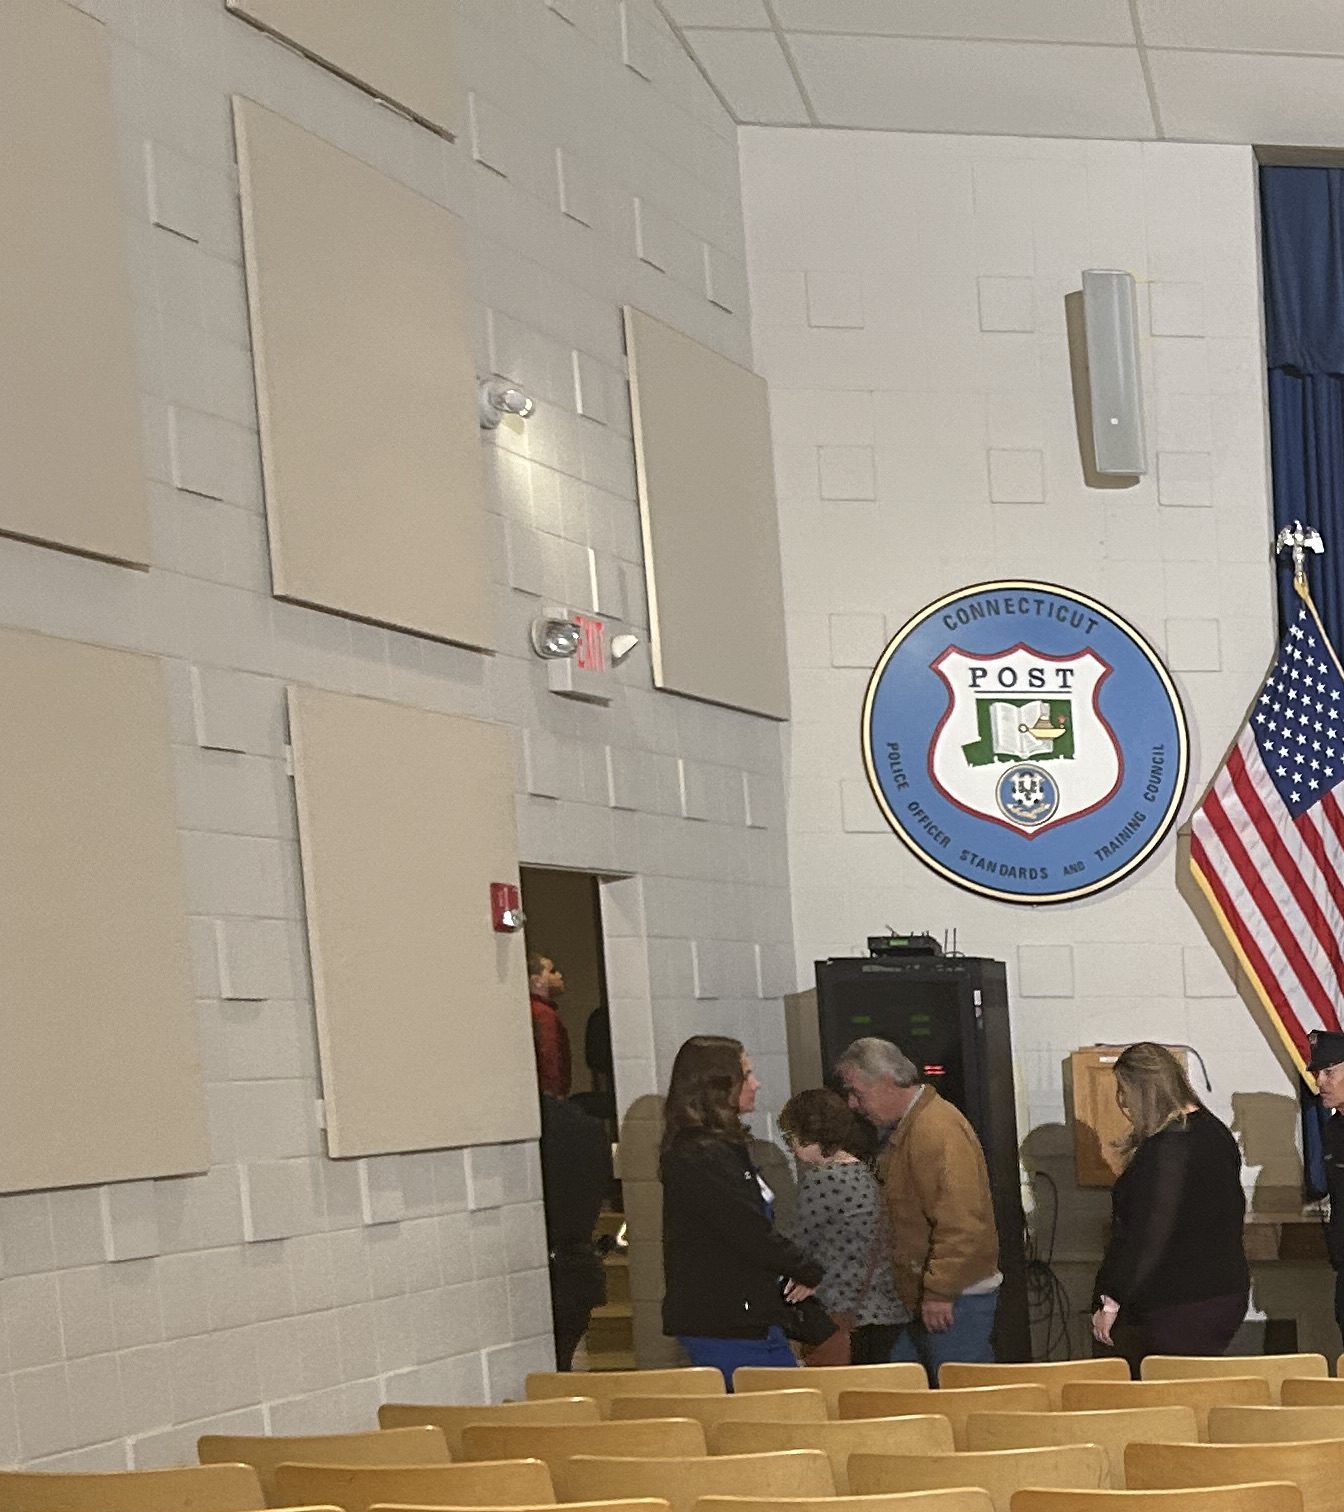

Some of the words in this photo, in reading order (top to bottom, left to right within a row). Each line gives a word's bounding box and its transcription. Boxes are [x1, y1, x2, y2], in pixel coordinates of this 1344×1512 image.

[943, 597, 1100, 635] CONNECTICUT
[886, 741, 910, 791] POLICE
[907, 800, 952, 849] OFFICER
[959, 848, 1049, 880] STANDARDS
[1063, 861, 1086, 877] AND
[1094, 810, 1147, 863] TRAINING
[1143, 743, 1165, 803] COUNCIL
